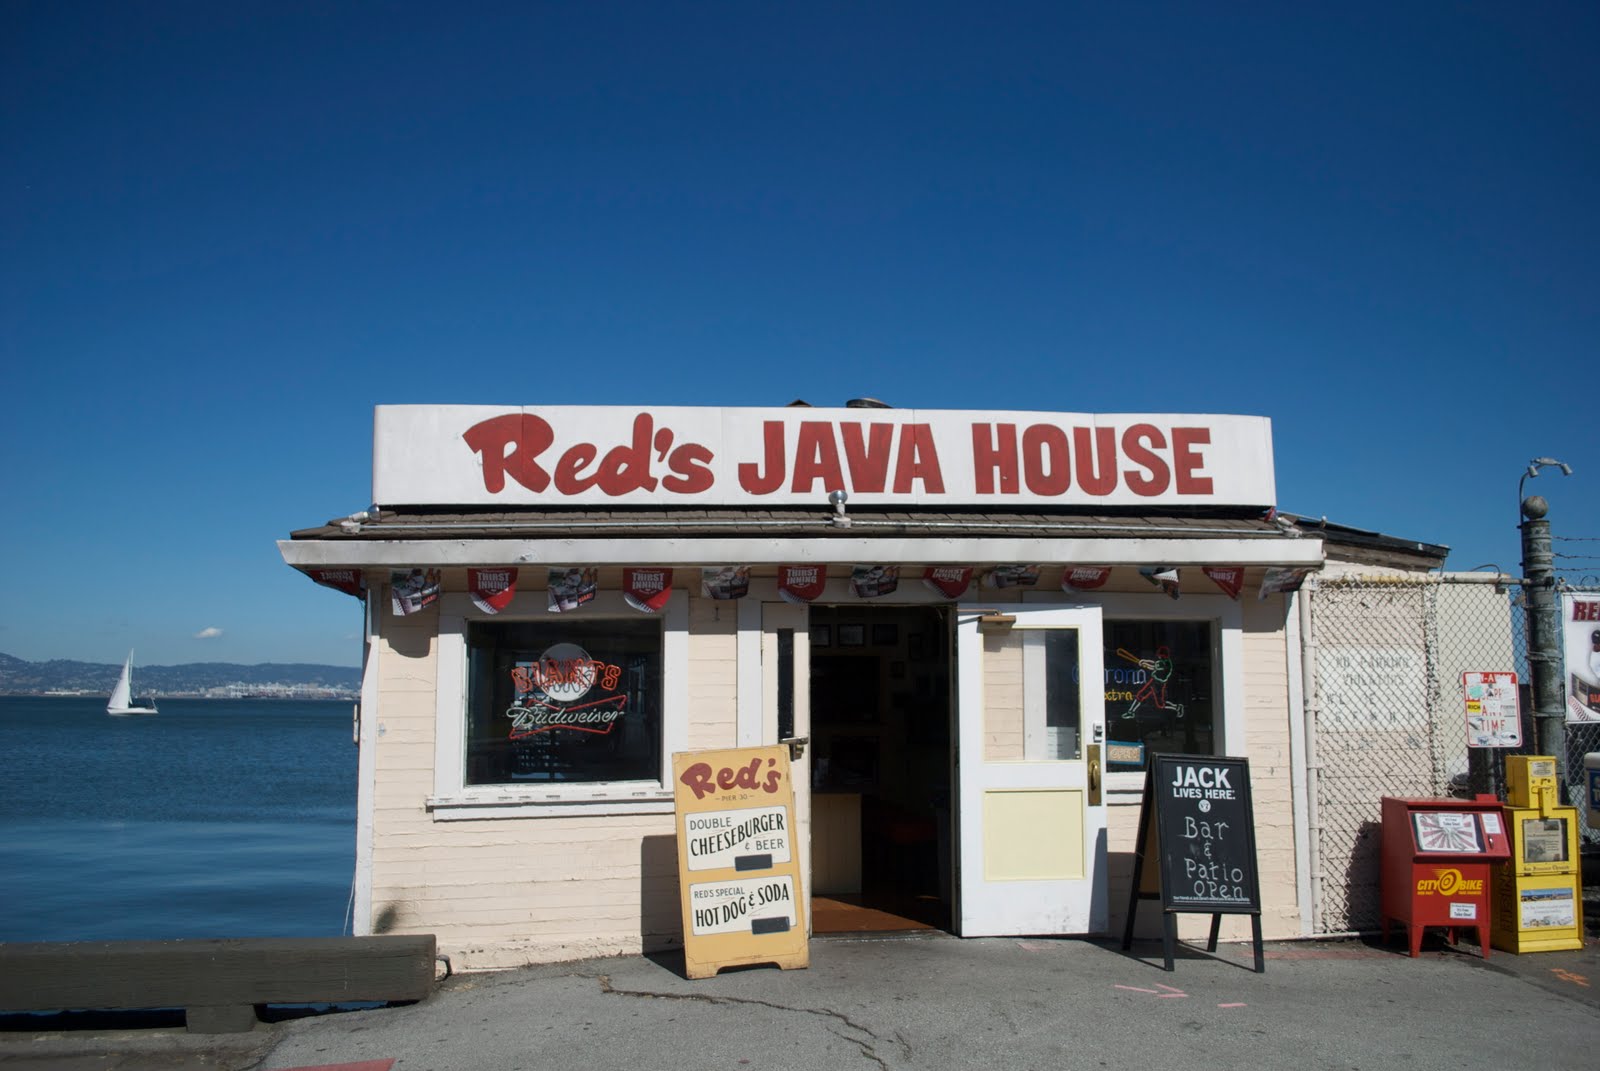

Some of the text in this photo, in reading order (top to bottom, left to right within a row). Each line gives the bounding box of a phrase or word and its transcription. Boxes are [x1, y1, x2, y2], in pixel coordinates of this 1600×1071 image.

[462, 412, 1214, 497] Red's JAVA HOUSE
[476, 572, 511, 581] THIRST
[631, 572, 665, 581] THIRST
[786, 568, 819, 577] THIRST
[632, 581, 664, 591] INNING
[506, 707, 625, 729] Budweiser
[679, 757, 782, 800] Red's
[1172, 766, 1232, 789] JACK
[721, 793, 748, 802] PIER 30
[1173, 787, 1203, 799] LIVES
[690, 816, 733, 831] DOUBLE
[1184, 816, 1230, 841] Bar
[690, 813, 785, 857] CHEESEBURGER
[756, 838, 785, 851] BEER
[1184, 857, 1244, 883] Patio
[1417, 879, 1483, 891] CITY BIKE
[715, 887, 745, 898] SPECIAL
[695, 907, 720, 928] HOT
[722, 896, 747, 923] DOG
[757, 883, 790, 905] SODA
